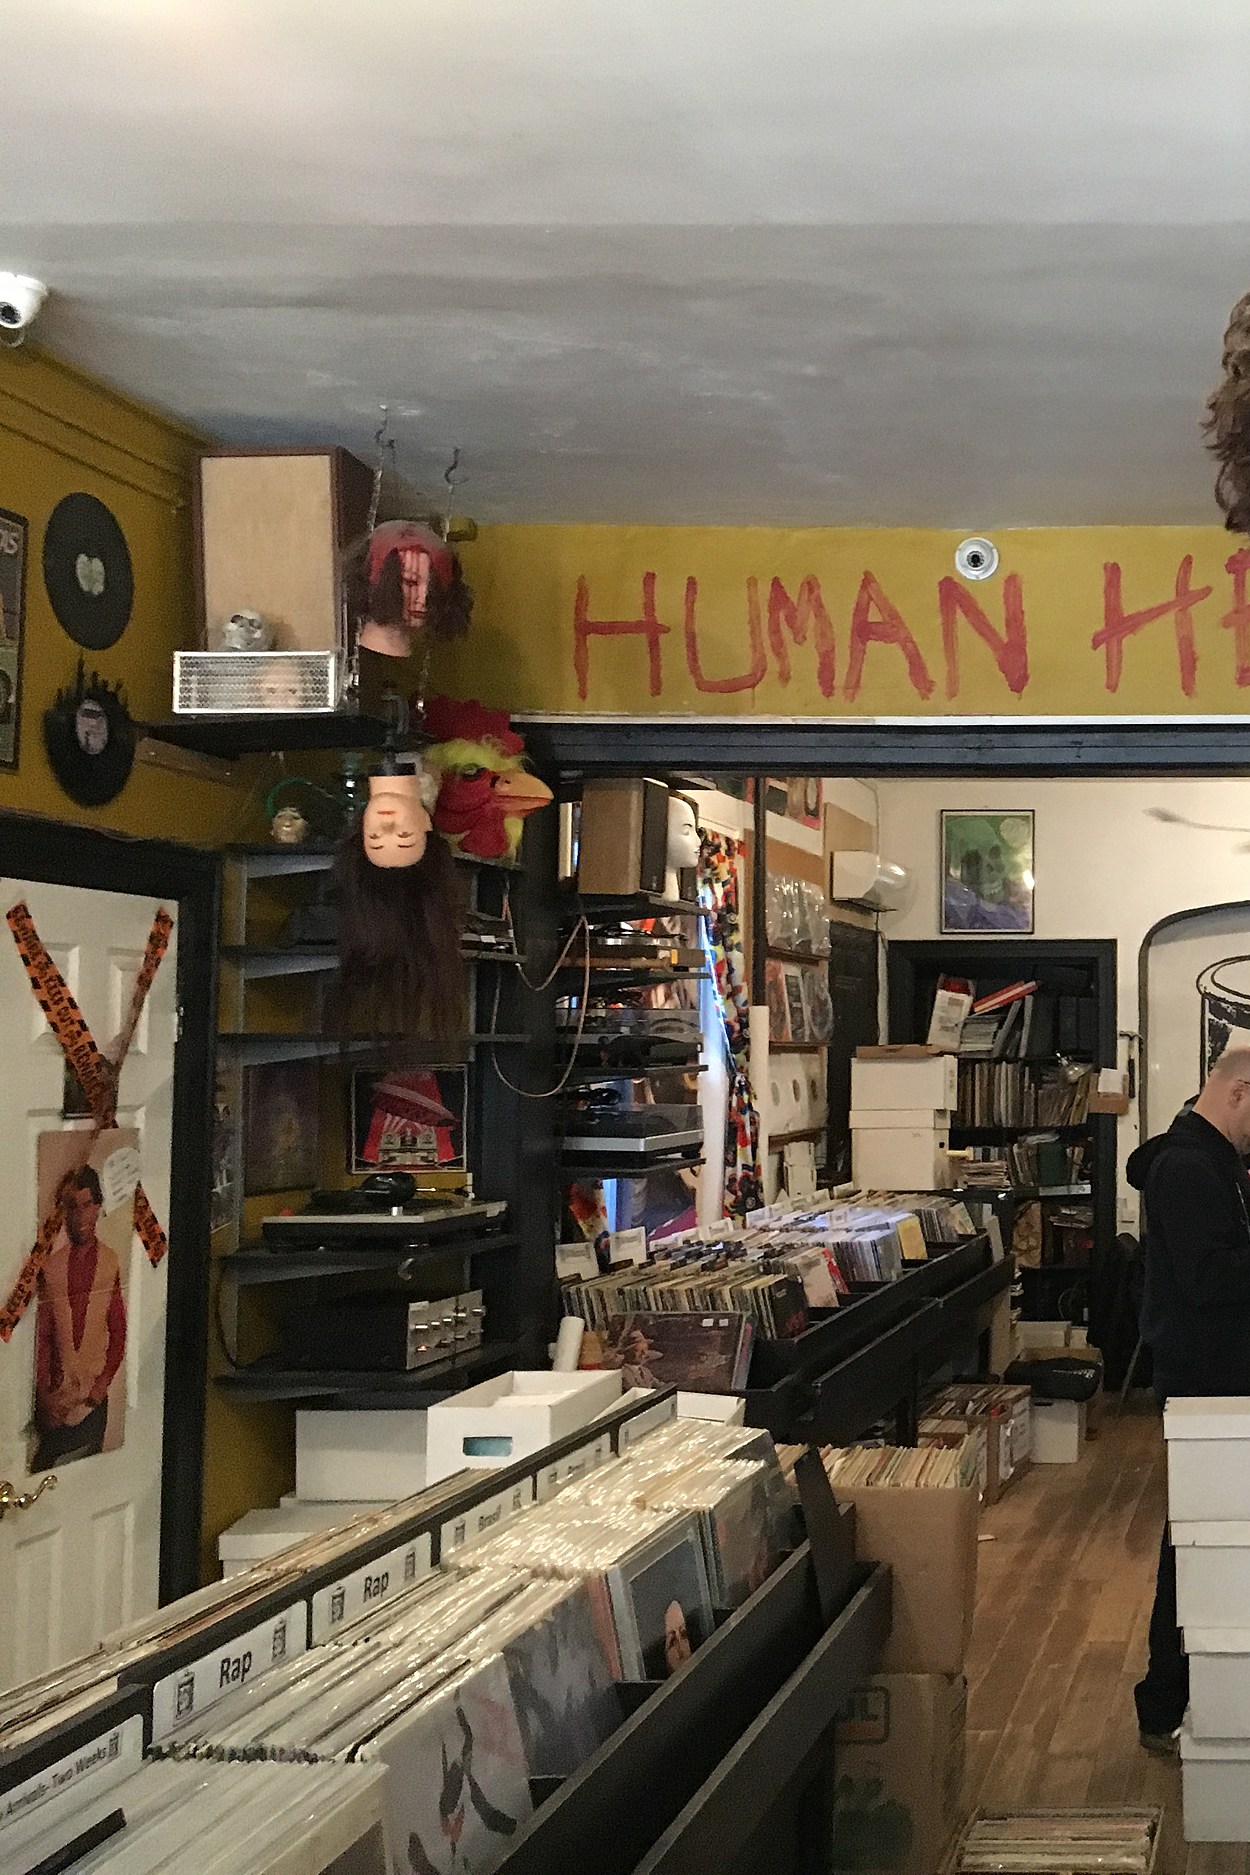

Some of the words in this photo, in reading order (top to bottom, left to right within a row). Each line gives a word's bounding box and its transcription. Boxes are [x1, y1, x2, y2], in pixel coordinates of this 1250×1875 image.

[574, 570, 1030, 701] HUMAN
[363, 1572, 389, 1603] Rap
[219, 1651, 252, 1688] Rap
[76, 1747, 106, 1774] Weeks
